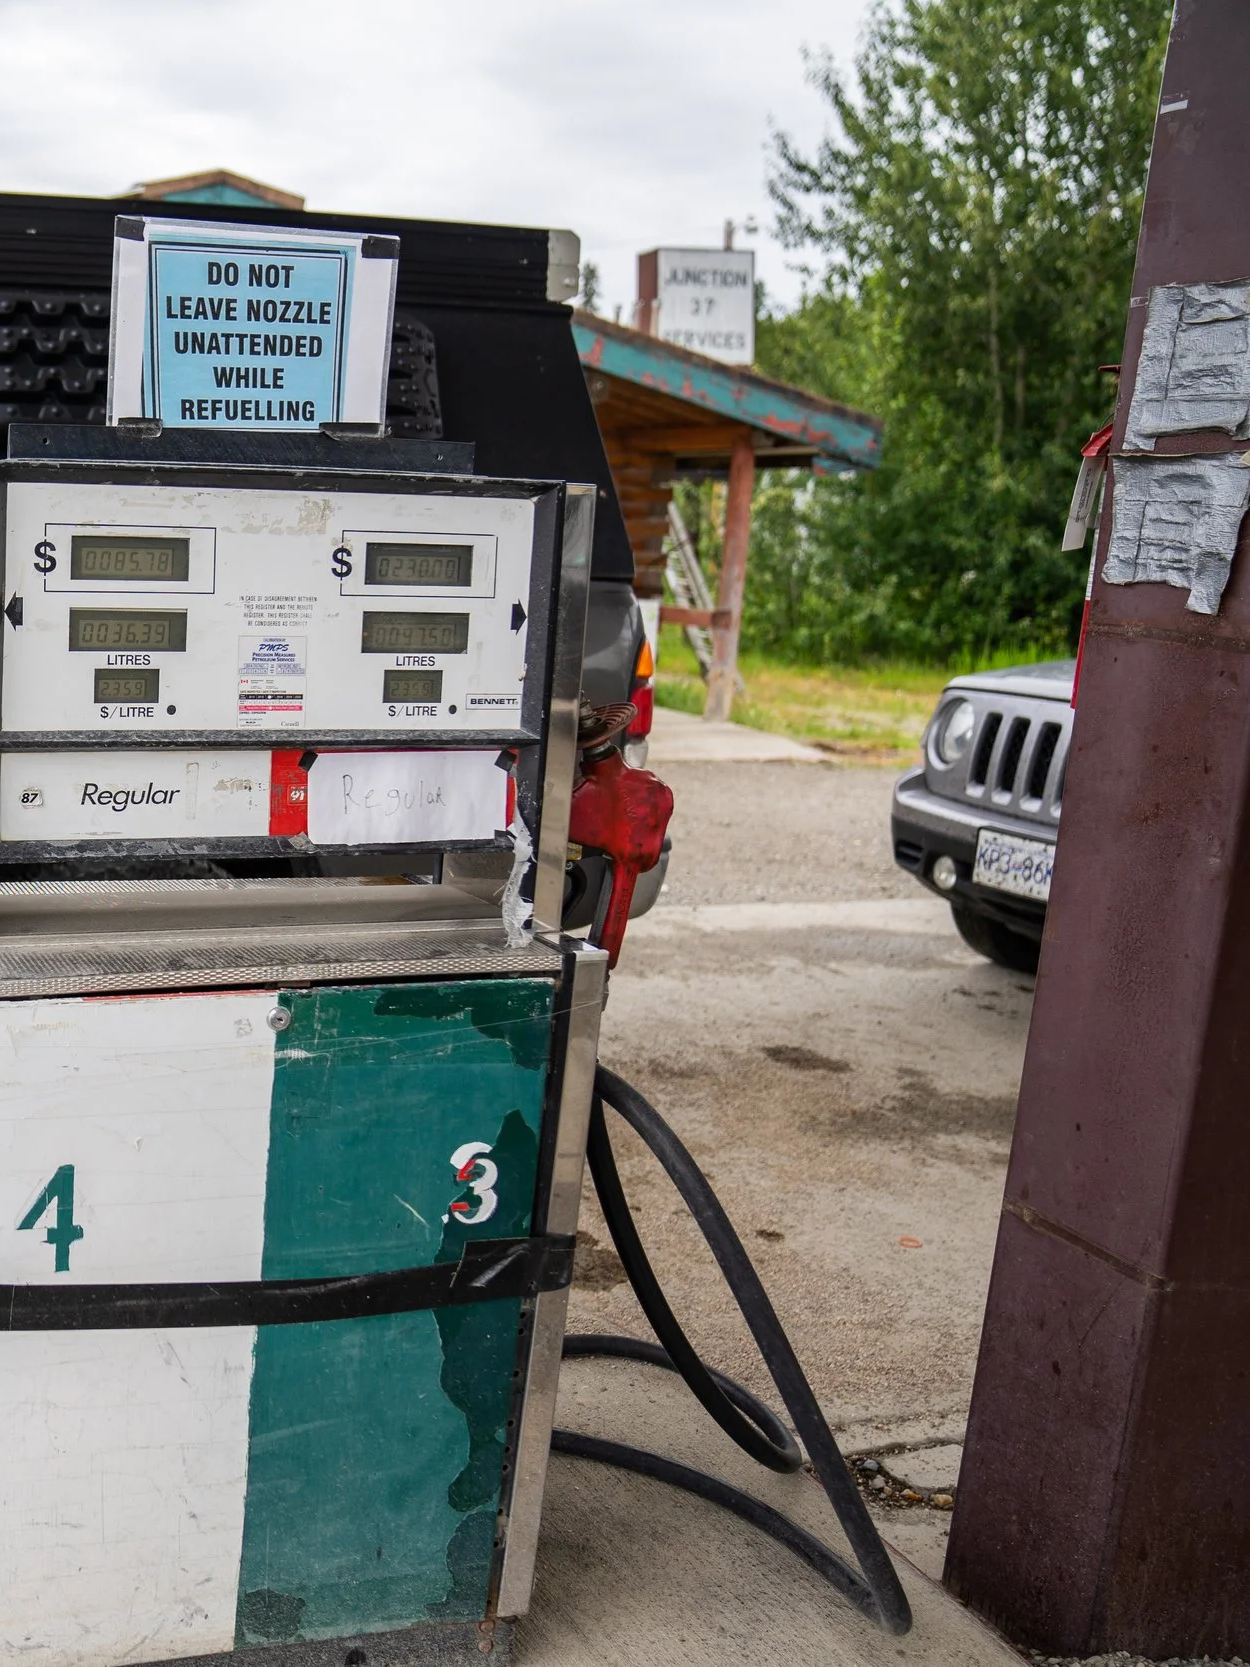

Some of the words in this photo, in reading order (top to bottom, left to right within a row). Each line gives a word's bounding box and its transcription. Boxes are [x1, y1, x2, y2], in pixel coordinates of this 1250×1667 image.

[207, 262, 239, 286] DO
[248, 264, 294, 288] NOT
[664, 268, 747, 287] JUNCTION
[166, 296, 237, 321] LEAVE
[247, 299, 332, 324] NOZZLE
[174, 331, 322, 358] UNATTENDED
[213, 366, 284, 389] WHILE
[180, 399, 315, 422] REFUELLING
[34, 539, 57, 576] $
[84, 551, 170, 572] 0085.78
[331, 545, 353, 581] $
[82, 622, 166, 644] 0036.39
[258, 643, 289, 651] PMPS
[107, 654, 151, 666] LITRES
[396, 655, 436, 667] LITRES
[21, 792, 39, 804] 87
[81, 782, 181, 812] Regular
[444, 1141, 499, 1224] 3
[16, 1164, 84, 1273] 4
